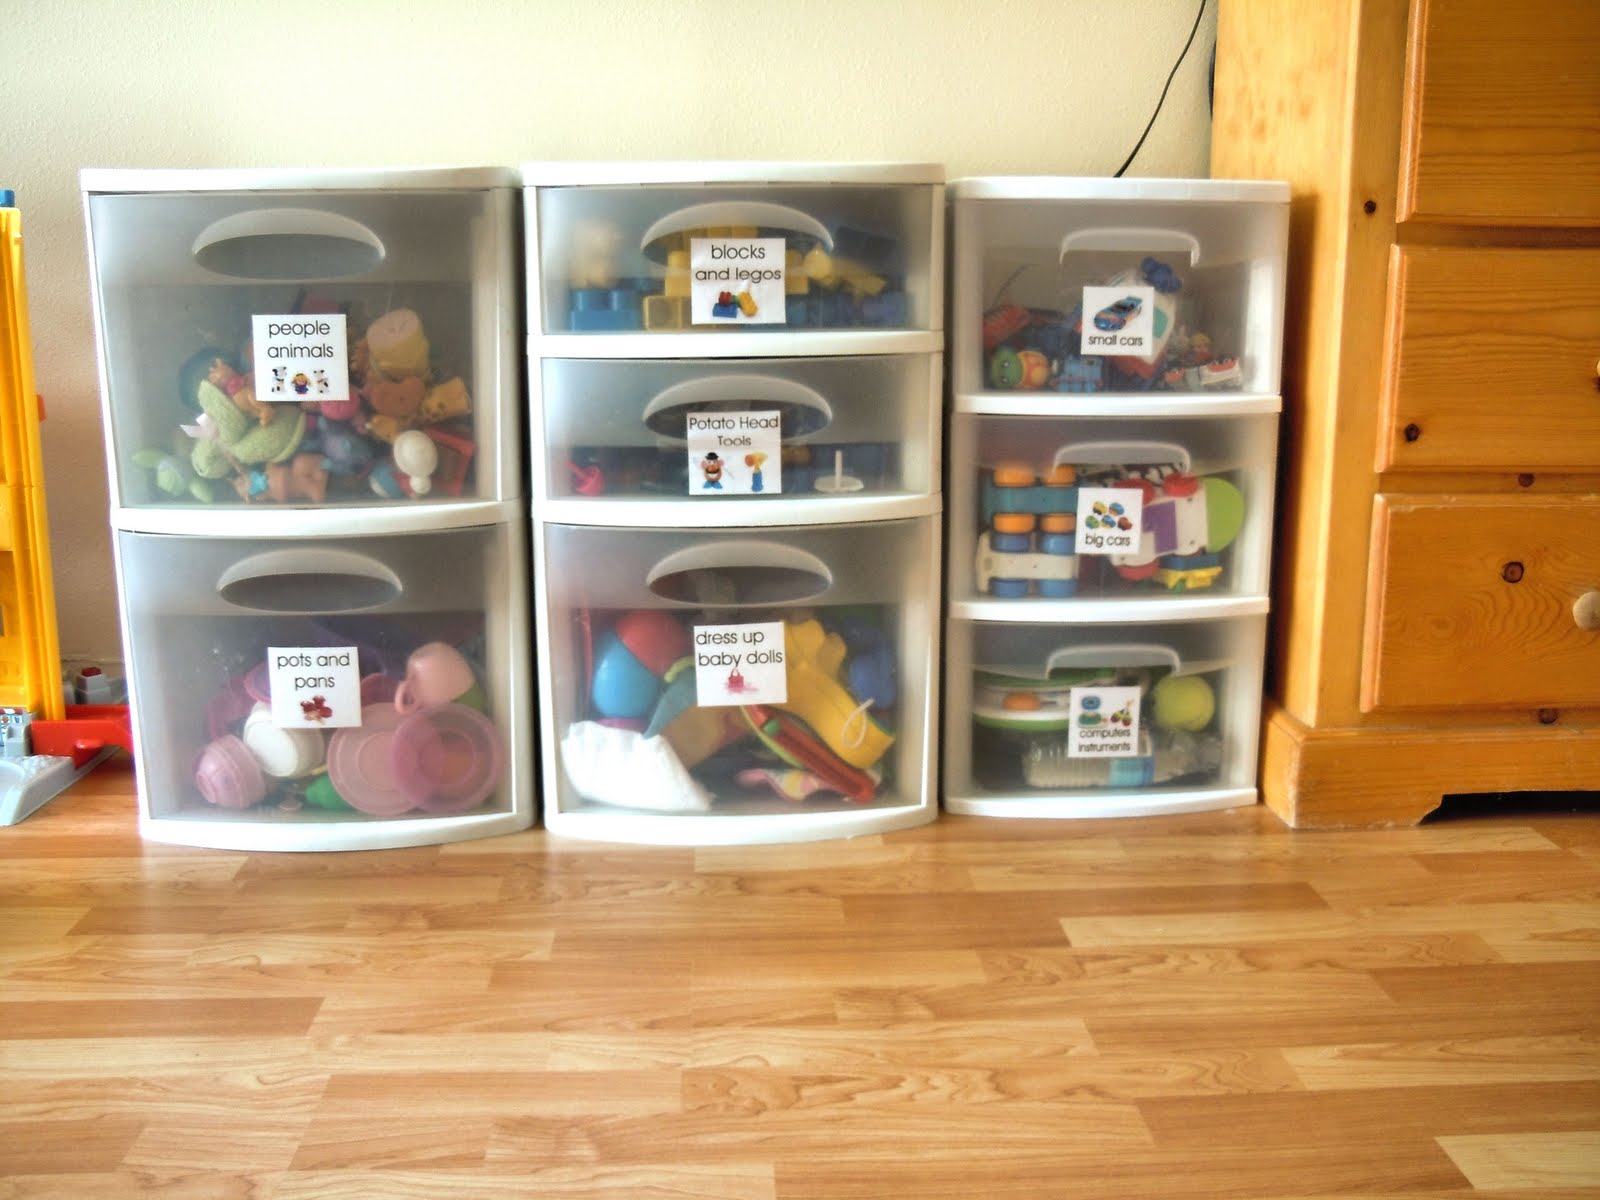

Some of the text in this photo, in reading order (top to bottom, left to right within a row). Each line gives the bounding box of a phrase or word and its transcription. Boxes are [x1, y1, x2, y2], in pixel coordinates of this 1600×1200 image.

[711, 245, 766, 260] blocks
[695, 267, 782, 284] and legos
[268, 320, 331, 339] people
[1088, 334, 1143, 347] small cars
[268, 343, 334, 359] animals
[689, 416, 779, 431] Potato Head
[717, 436, 752, 447] Tools
[1084, 533, 1131, 549] big cars
[695, 631, 765, 646] dress up
[276, 652, 350, 670] pots and
[698, 650, 783, 669] baby dolls
[294, 676, 336, 692] pans
[1078, 727, 1132, 740] computers
[1078, 742, 1131, 753] instruments
